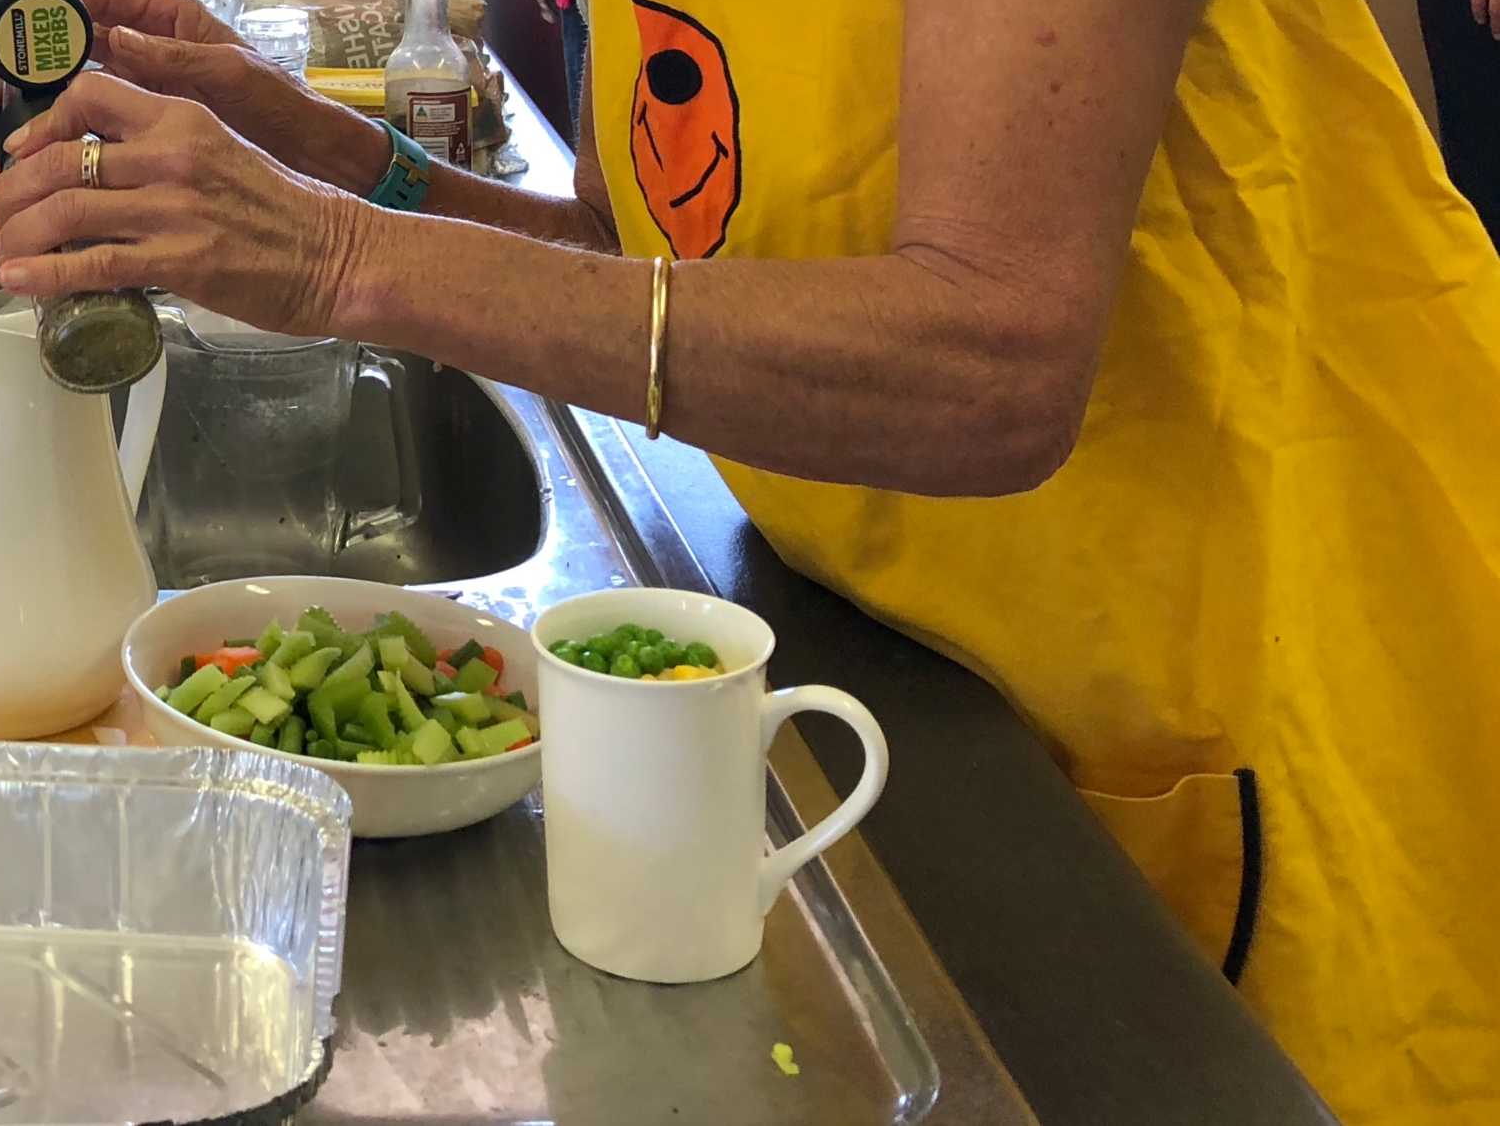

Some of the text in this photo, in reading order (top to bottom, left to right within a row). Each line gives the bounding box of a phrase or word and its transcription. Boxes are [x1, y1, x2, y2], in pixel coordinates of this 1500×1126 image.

[13, 14, 28, 72] STONEMILL
[31, 7, 53, 72] MIXED
[50, 5, 71, 70] HERBS
